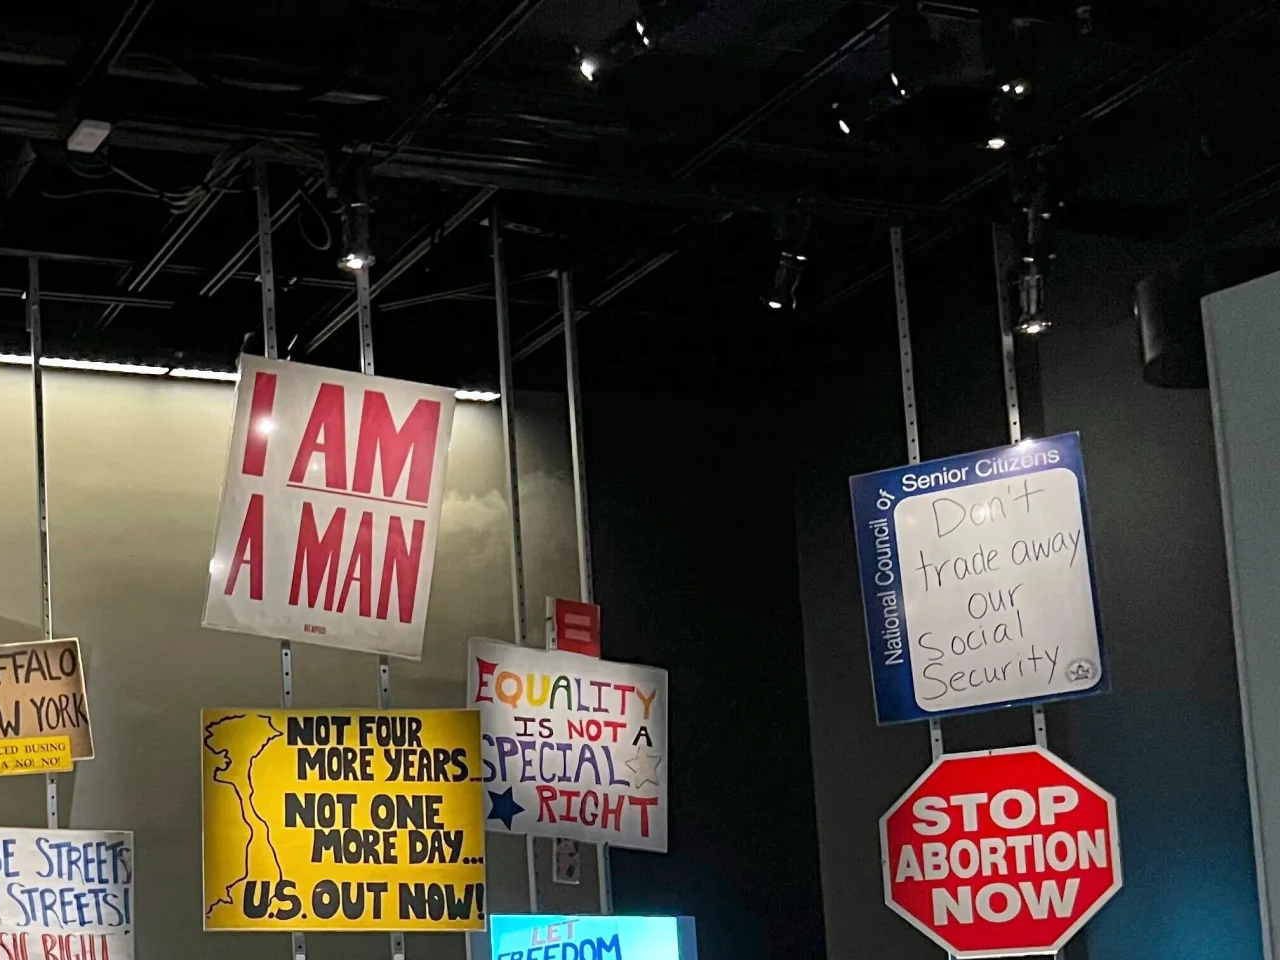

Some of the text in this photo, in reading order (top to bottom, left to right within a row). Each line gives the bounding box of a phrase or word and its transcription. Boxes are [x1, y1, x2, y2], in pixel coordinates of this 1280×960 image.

[242, 371, 441, 503] I AM
[902, 448, 1060, 492] Senior Citizens
[932, 479, 1045, 538] Don't
[224, 494, 425, 624] A MAN
[869, 489, 904, 666] National Council of
[916, 528, 1080, 592] trade away
[968, 583, 1024, 620] our
[918, 610, 1024, 662] Social
[475, 656, 657, 720] EQUALITY
[922, 644, 1060, 700] Security
[30, 693, 88, 732] YORK
[287, 716, 423, 747] NOT FOUR
[514, 716, 652, 746] IS NOT A
[1, 761, 8, 769] A
[41, 758, 60, 766] NO!
[25, 743, 66, 753] BUSING
[297, 748, 374, 781] MORE
[482, 734, 630, 787] SPECIAL
[285, 793, 444, 830] NOT ONE
[536, 785, 658, 838] RIGHT
[912, 785, 1079, 836] STOP
[35, 838, 131, 885] STREETS
[311, 830, 398, 864] MORE
[895, 829, 1107, 883] ABORTION
[7, 882, 130, 928] STREETS!
[244, 880, 484, 920] U.S. OUT NOW!
[932, 878, 1081, 926] NOW
[532, 919, 579, 945] LET
